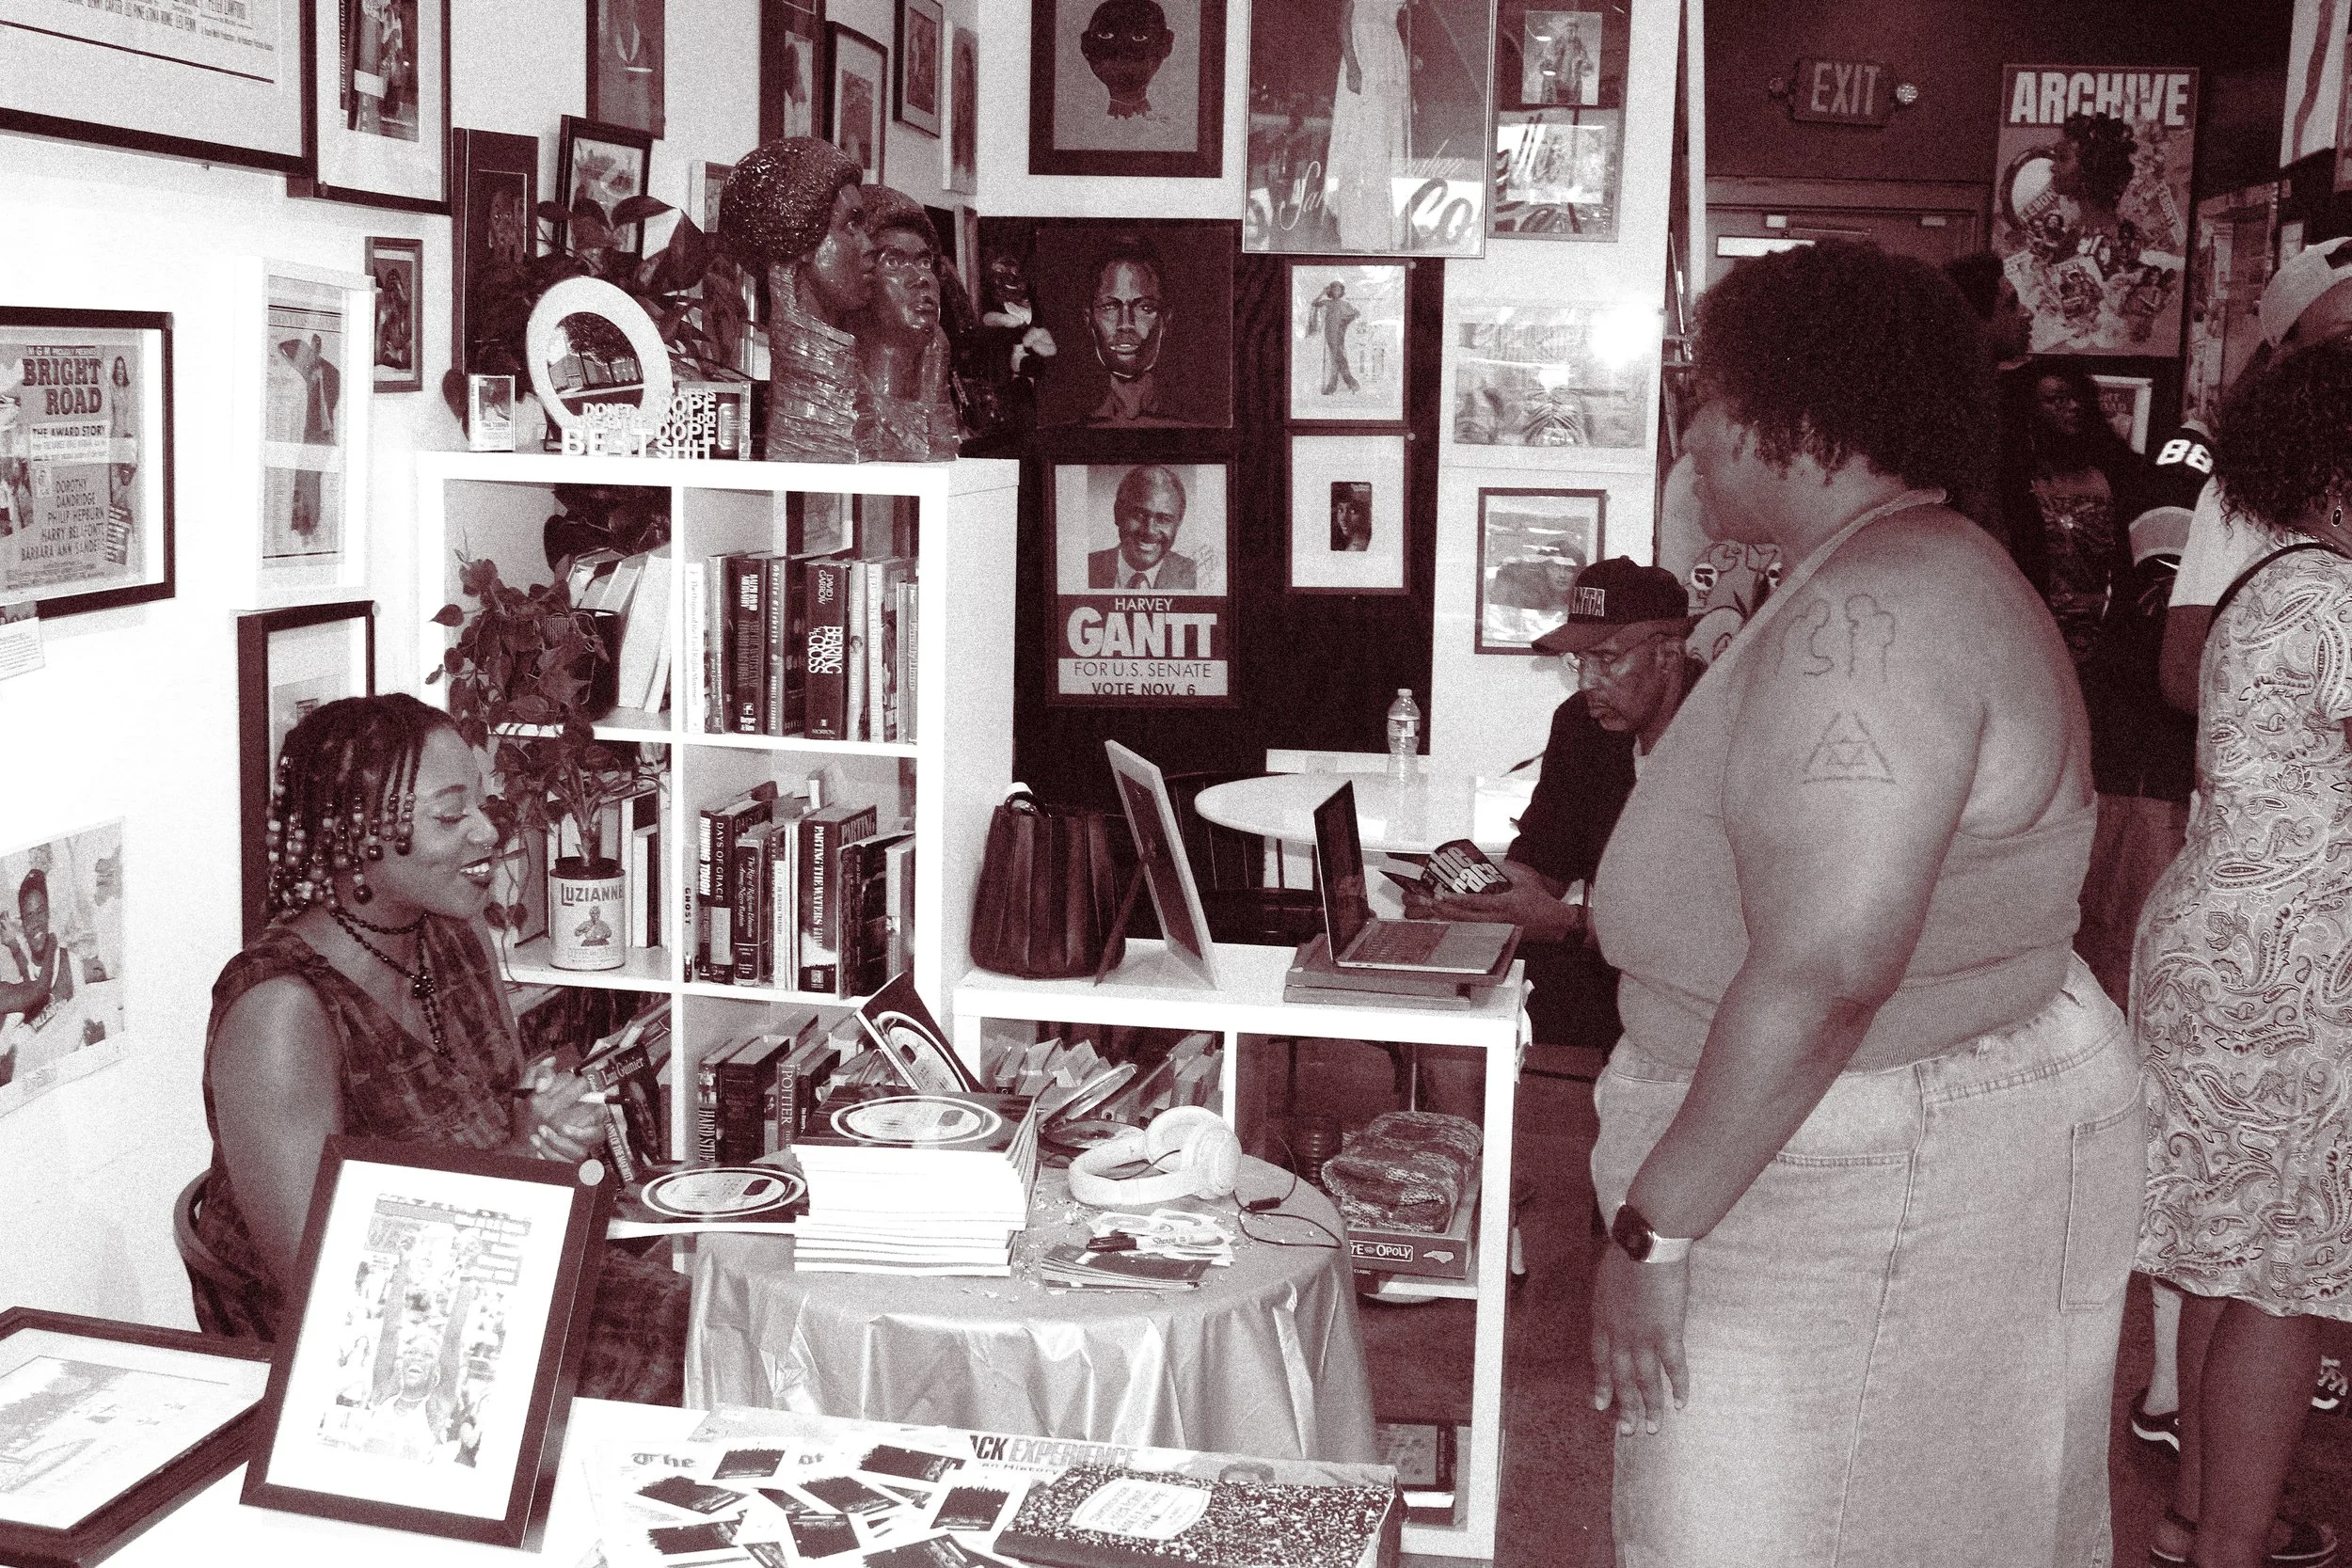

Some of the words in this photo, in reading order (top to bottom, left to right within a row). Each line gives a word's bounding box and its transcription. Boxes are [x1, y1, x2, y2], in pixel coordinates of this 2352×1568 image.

[1811, 62, 1881, 117] EXIT
[2009, 71, 2190, 126] ARCHIVE
[23, 357, 102, 387] BRIGHT
[46, 387, 103, 415] ROAD
[32, 427, 48, 436] THE
[51, 425, 80, 436] AWARD
[82, 424, 105, 436] STORY
[658, 423, 716, 440] DOPE
[658, 439, 716, 460] SHIT
[56, 478, 87, 494] DOROTHY
[56, 492, 96, 508] DANDRIDGE
[21, 545, 55, 562] BARBARA
[56, 543, 73, 557] ANN
[818, 569, 827, 605] GARROW
[1115, 597, 1173, 611] HARVEY
[1066, 607, 1217, 657] GANTT
[808, 635, 825, 673] CROSS
[825, 626, 843, 674] BEARING
[1074, 662, 1107, 676] FOR
[1113, 662, 1143, 677] U.S.
[1148, 662, 1212, 677] SENATE
[1091, 682, 1135, 696] VOTE
[1140, 683, 1180, 696] NOV.
[1186, 684, 1196, 696] 6
[700, 816, 711, 863] RUNNING
[813, 825, 824, 864] PARTING
[716, 850, 723, 863] OF
[1428, 847, 1475, 886] the
[700, 863, 711, 895] TOUGH
[813, 864, 824, 885] THE
[1452, 863, 1509, 895] race
[561, 883, 625, 907] LUZIANNE
[814, 885, 824, 926] WATERS
[616, 1055, 644, 1078] Guinier
[781, 1069, 794, 1125] POITIER
[699, 1109, 716, 1137] HARD
[1008, 1438, 1138, 1469] EXPERIENCE
